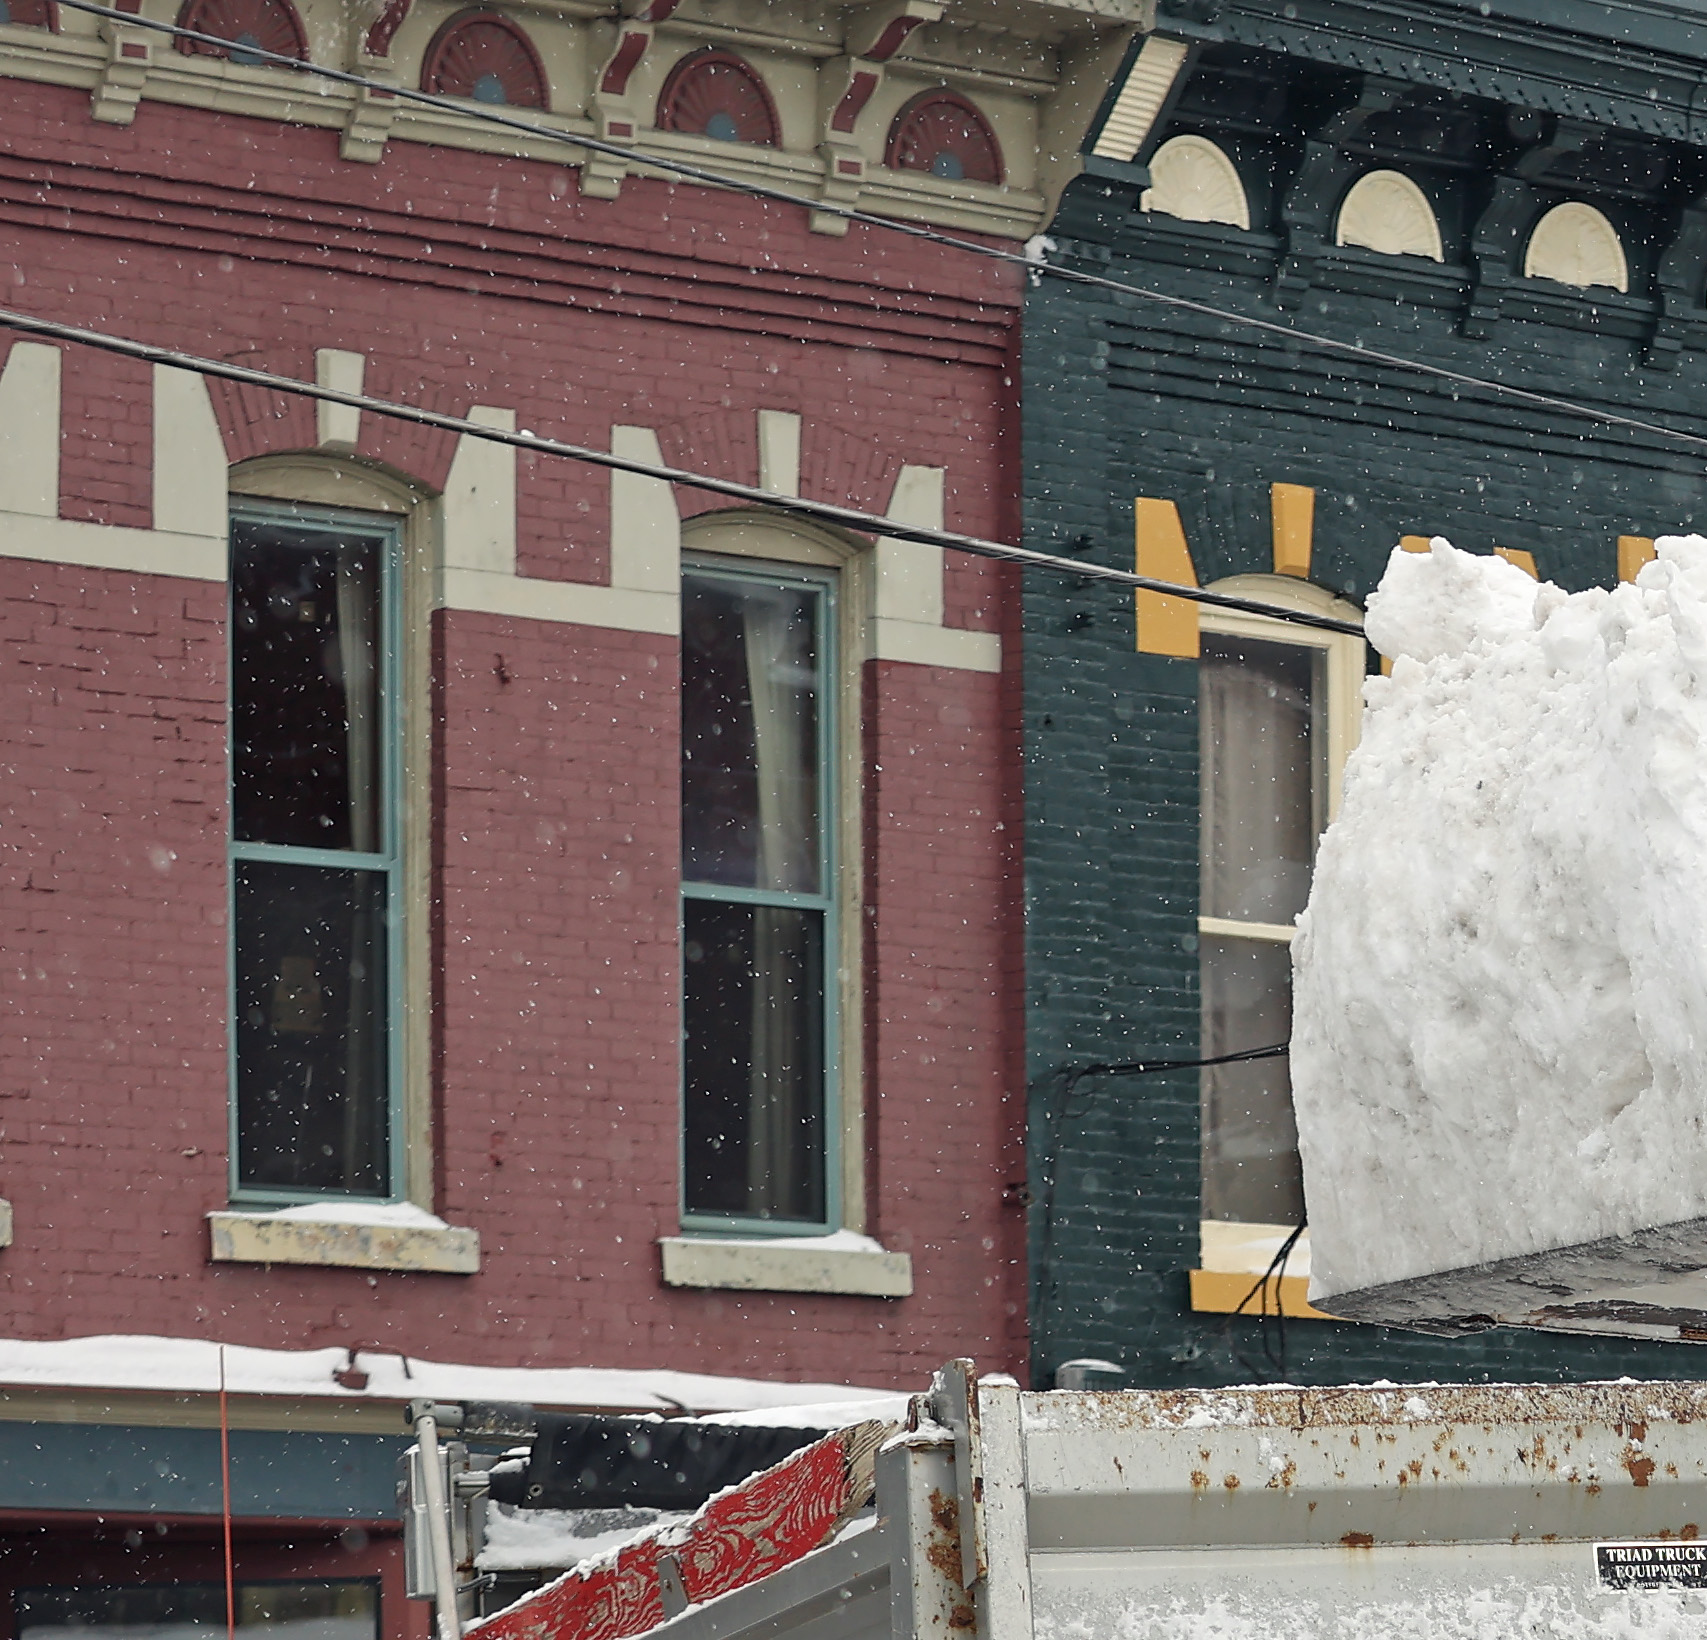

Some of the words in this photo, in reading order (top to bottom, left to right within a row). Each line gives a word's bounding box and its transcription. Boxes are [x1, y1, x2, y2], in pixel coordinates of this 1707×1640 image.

[1606, 1548, 1653, 1562] TRIAD
[1655, 1547, 1707, 1561] TRUCK
[1615, 1563, 1702, 1579] EQUIPMENT
